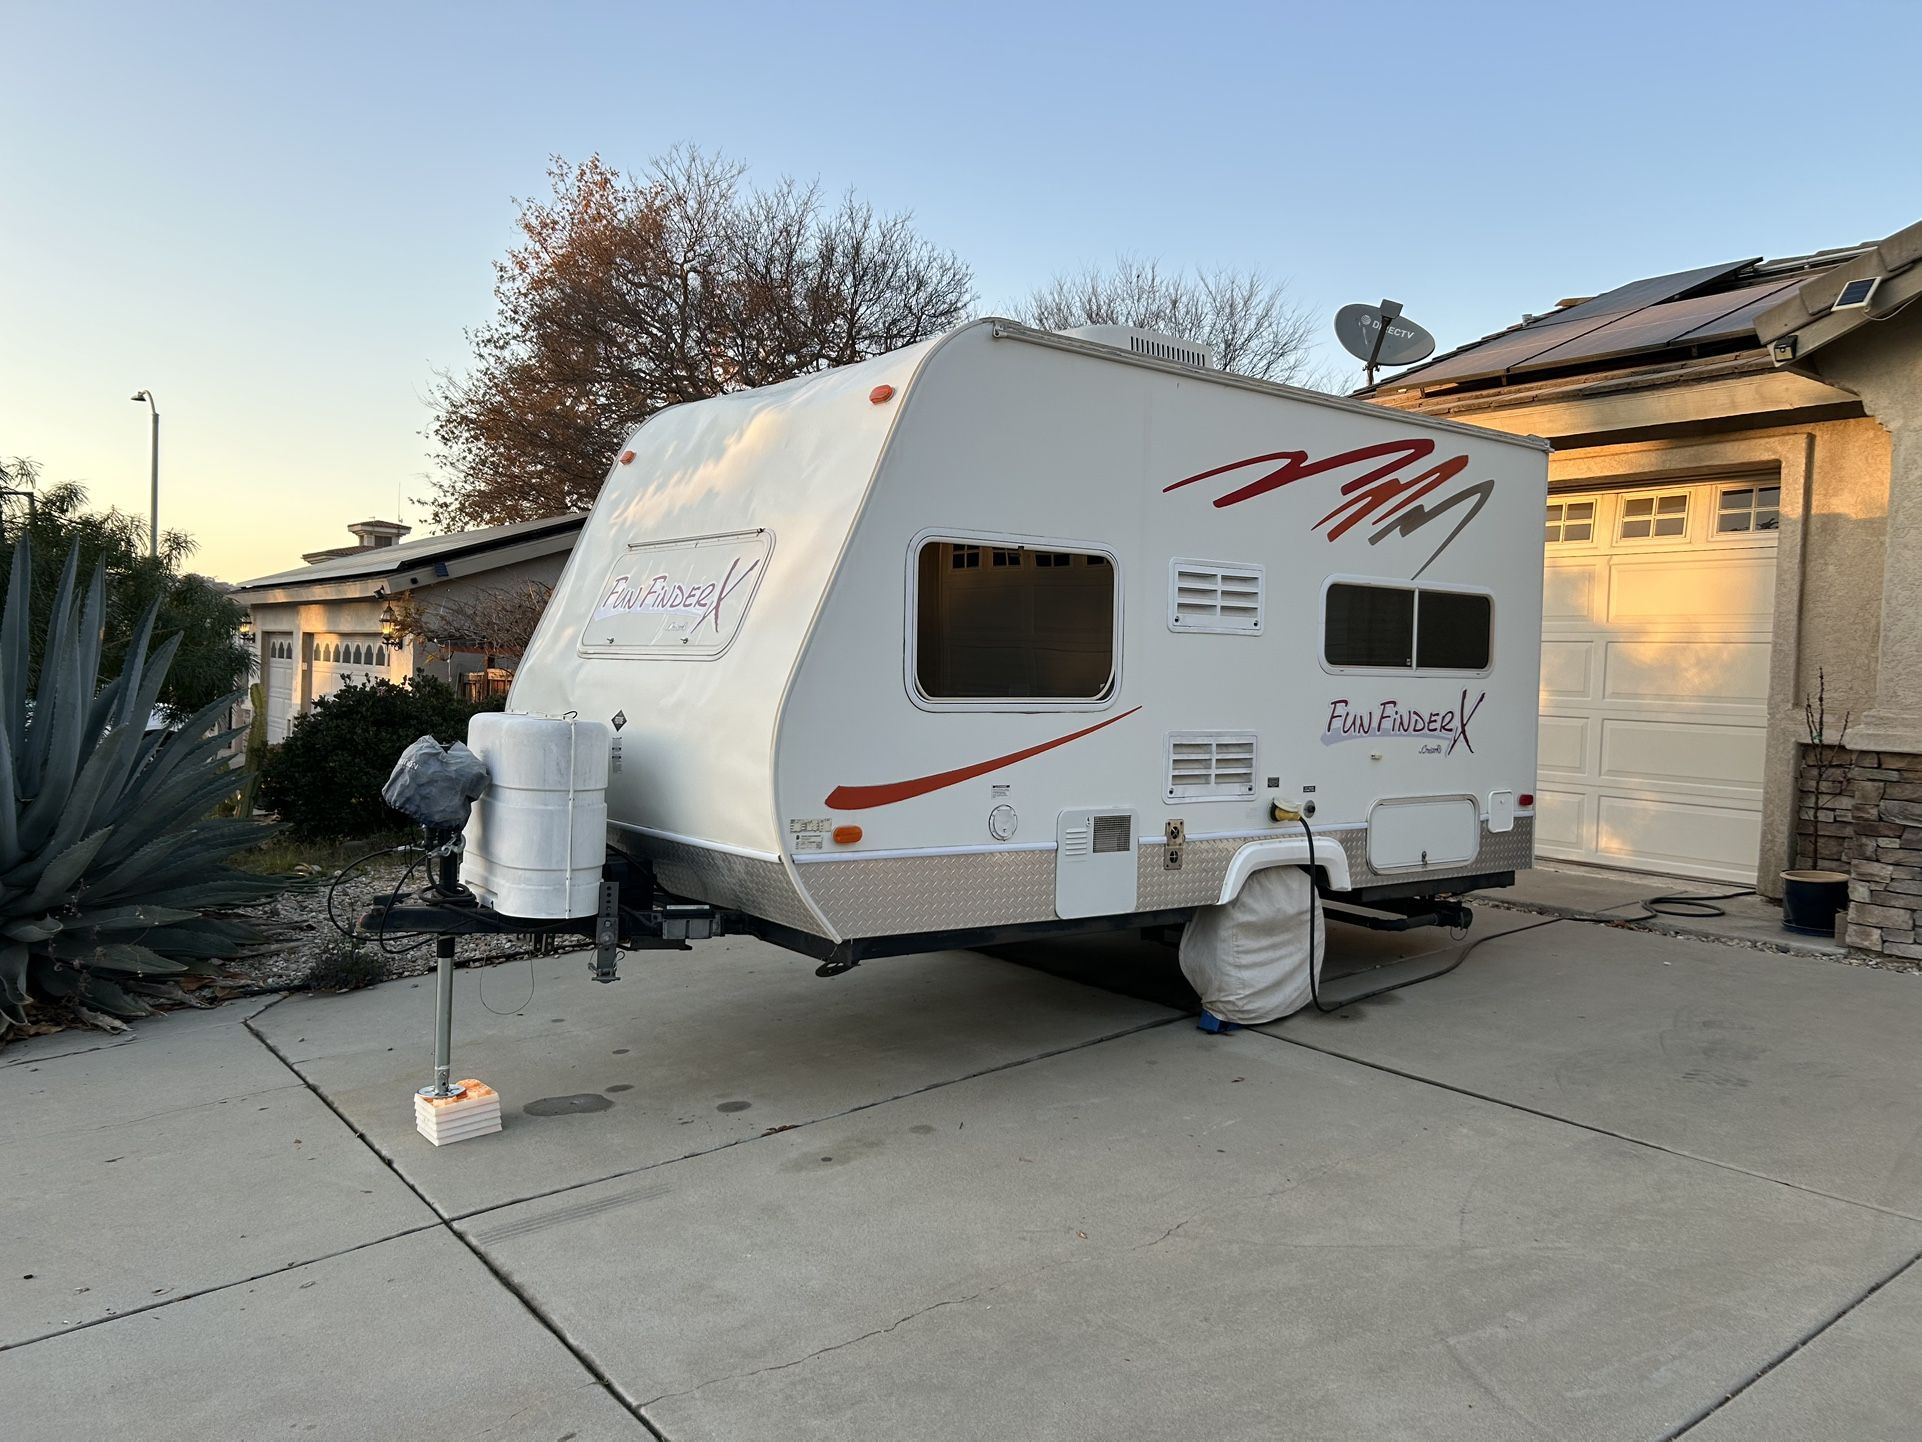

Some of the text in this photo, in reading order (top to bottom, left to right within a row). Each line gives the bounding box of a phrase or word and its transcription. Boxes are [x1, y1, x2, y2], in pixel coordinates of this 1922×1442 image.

[1372, 320, 1415, 339] DIECTV
[602, 576, 643, 610] FUN
[1327, 699, 1372, 734] FUN
